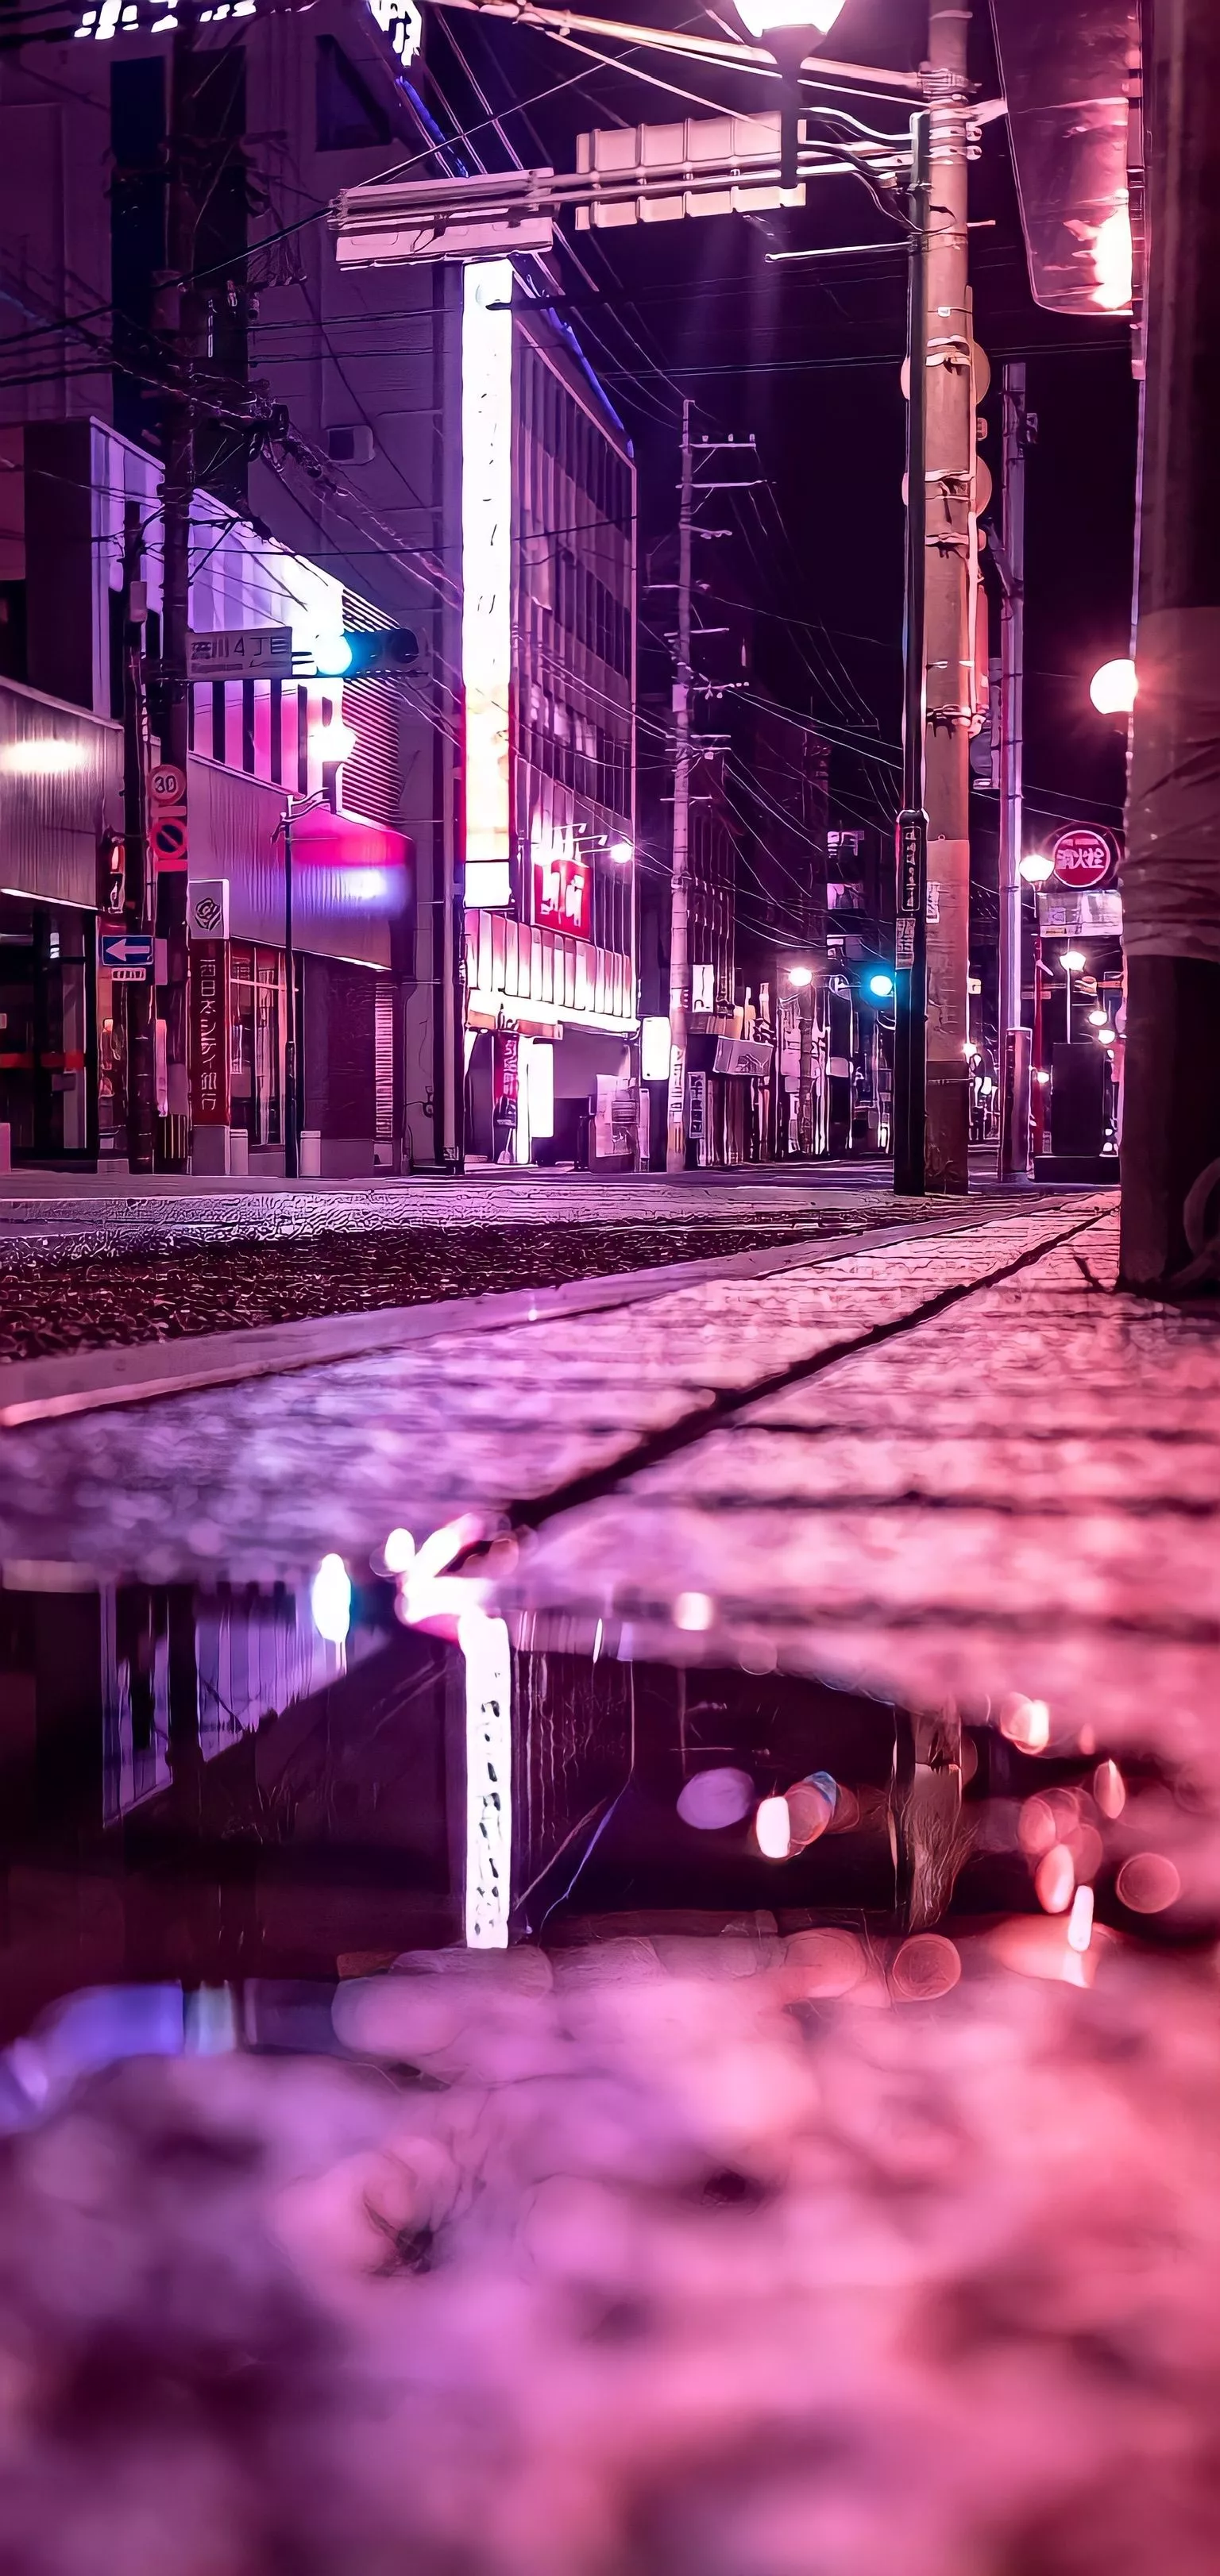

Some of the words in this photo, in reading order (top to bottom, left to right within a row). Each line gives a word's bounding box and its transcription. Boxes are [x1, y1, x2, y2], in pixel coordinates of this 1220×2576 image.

[154, 775, 176, 793] 30
[1056, 847, 1105, 870] 消火栓
